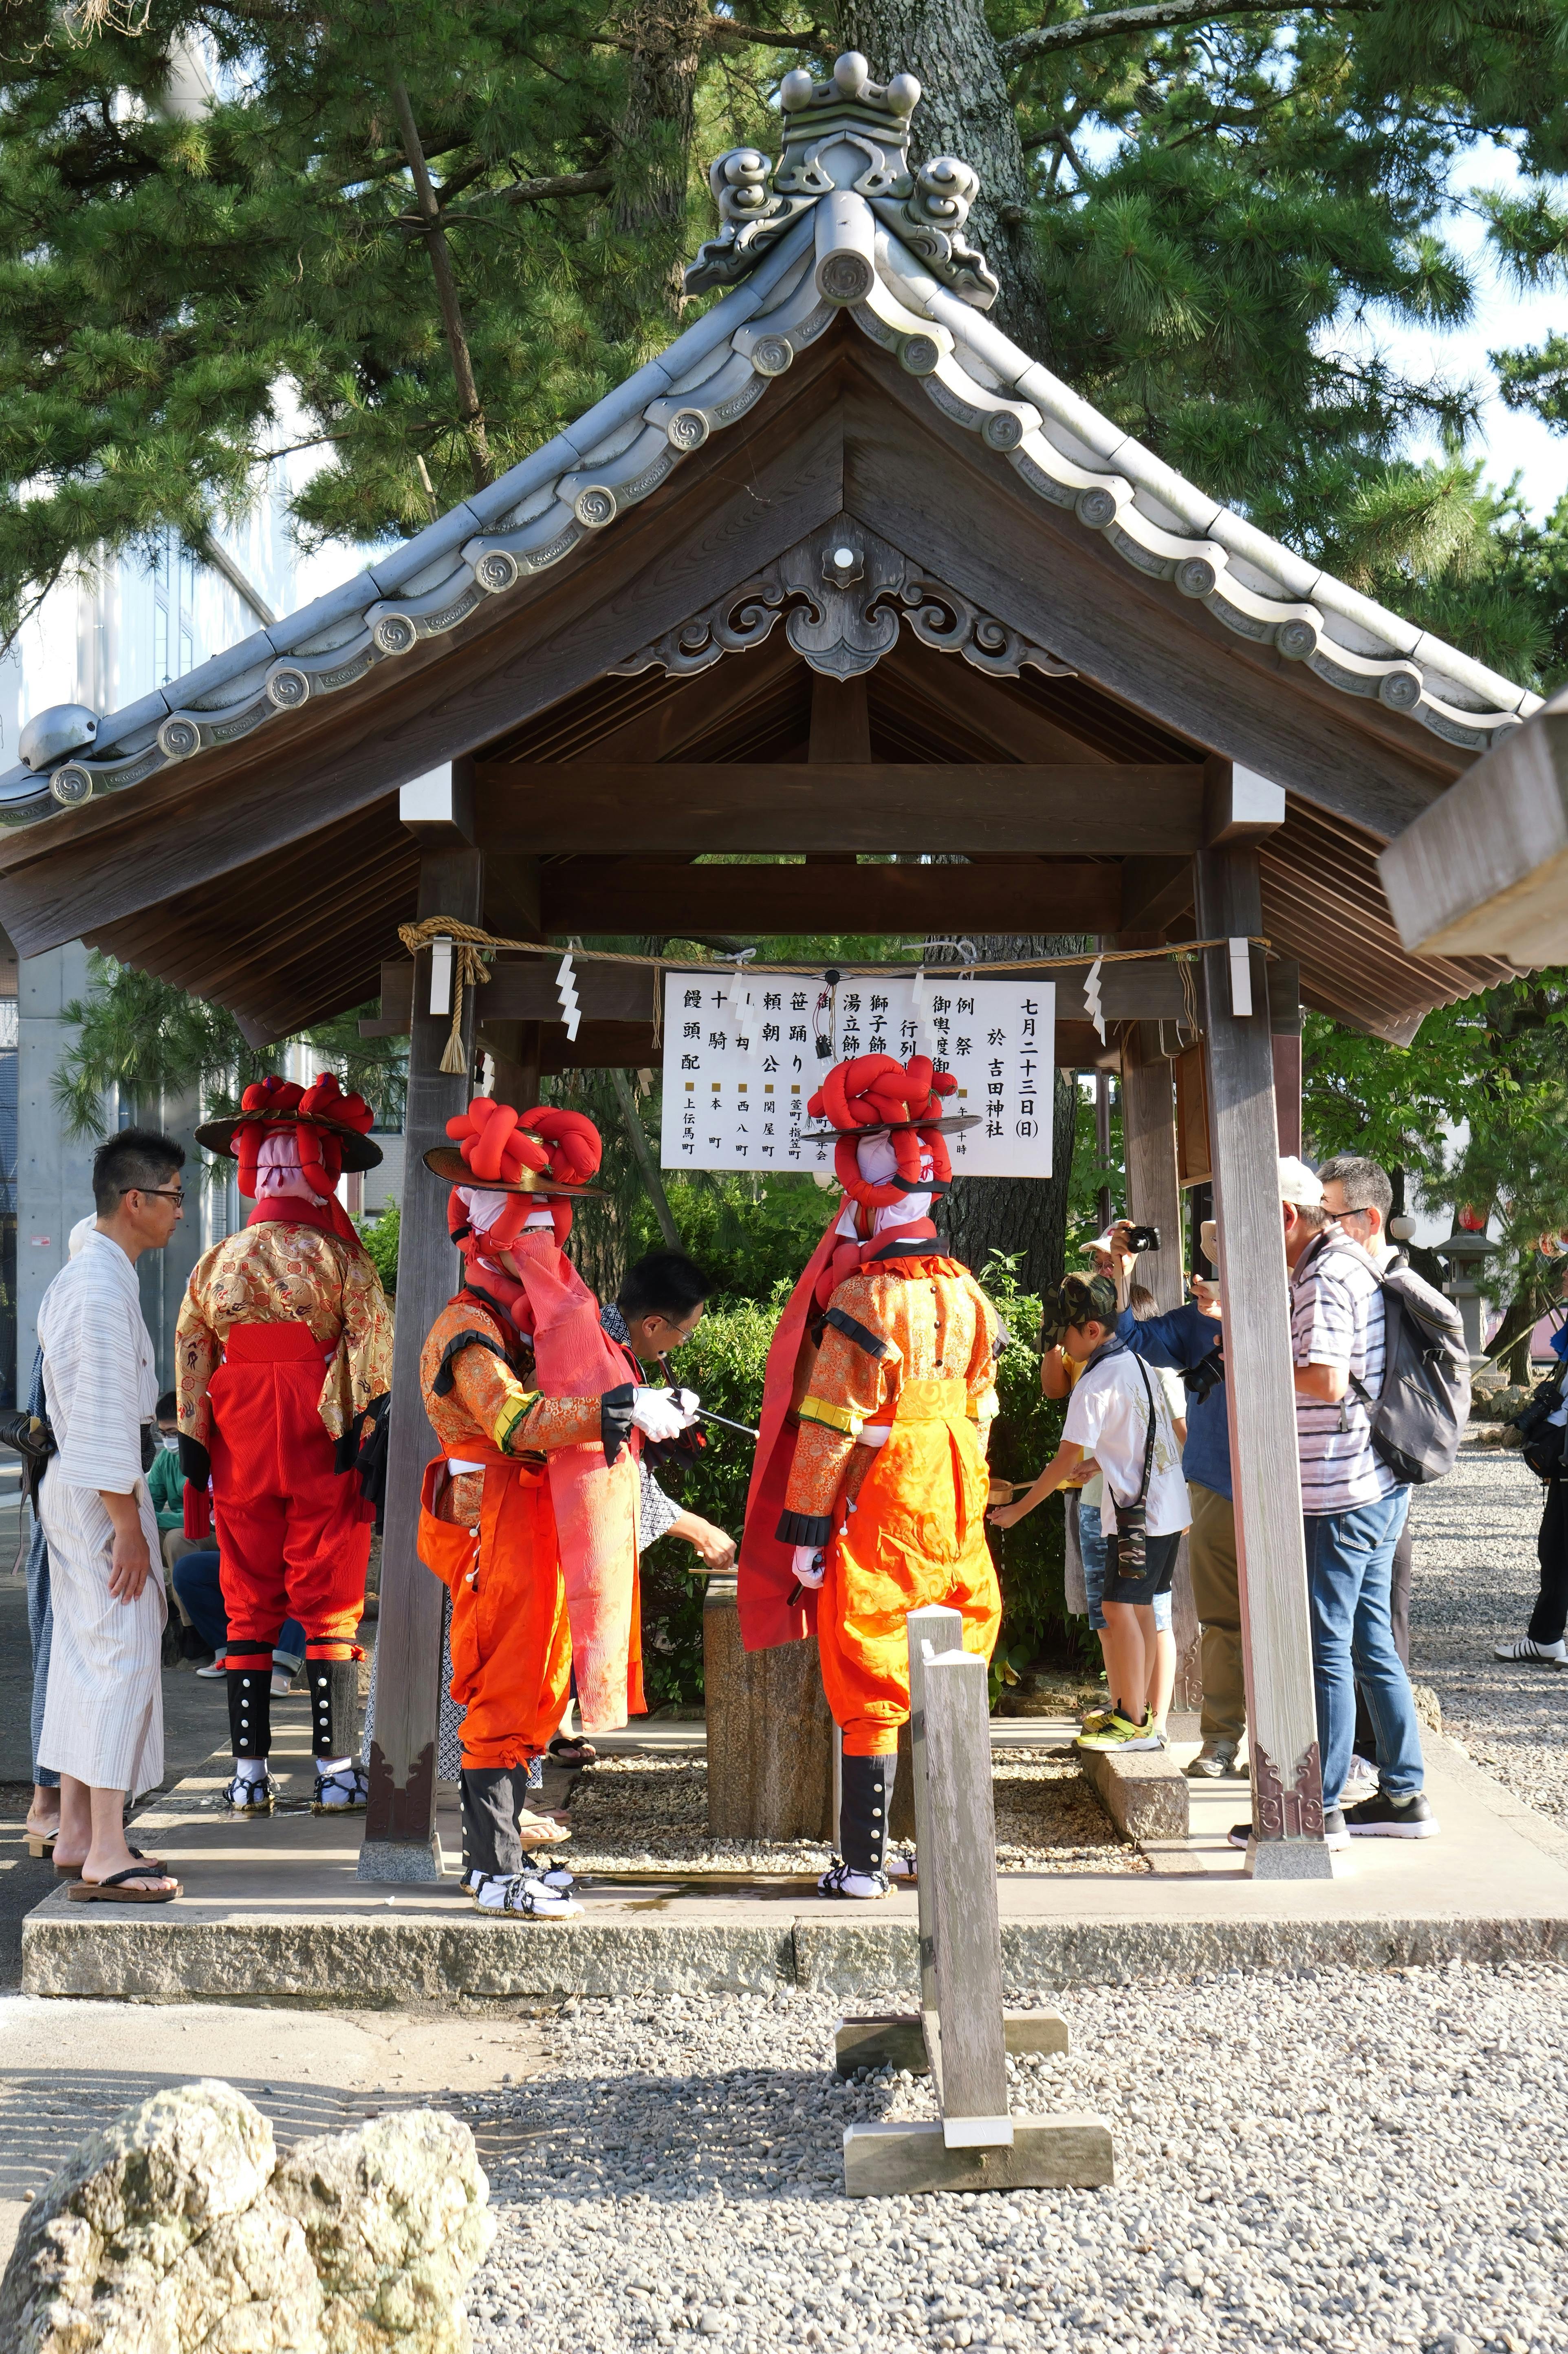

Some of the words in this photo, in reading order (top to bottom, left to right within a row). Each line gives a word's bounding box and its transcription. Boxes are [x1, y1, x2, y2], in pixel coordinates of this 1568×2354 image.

[681, 990, 702, 1070] 饅頭配
[708, 990, 728, 1050] 十騎
[735, 993, 755, 1051] 母
[762, 992, 782, 1073] 頼朝公
[788, 992, 808, 1073] 笹踊り
[842, 994, 861, 1062] 湯立飾
[955, 997, 974, 1056] 例祭
[682, 1098, 695, 1155] 上伝馬町
[709, 1098, 722, 1149] 本町
[736, 1101, 749, 1157] 西八町
[762, 1101, 775, 1157] 関屋町
[956, 1106, 968, 1155] 午十時
